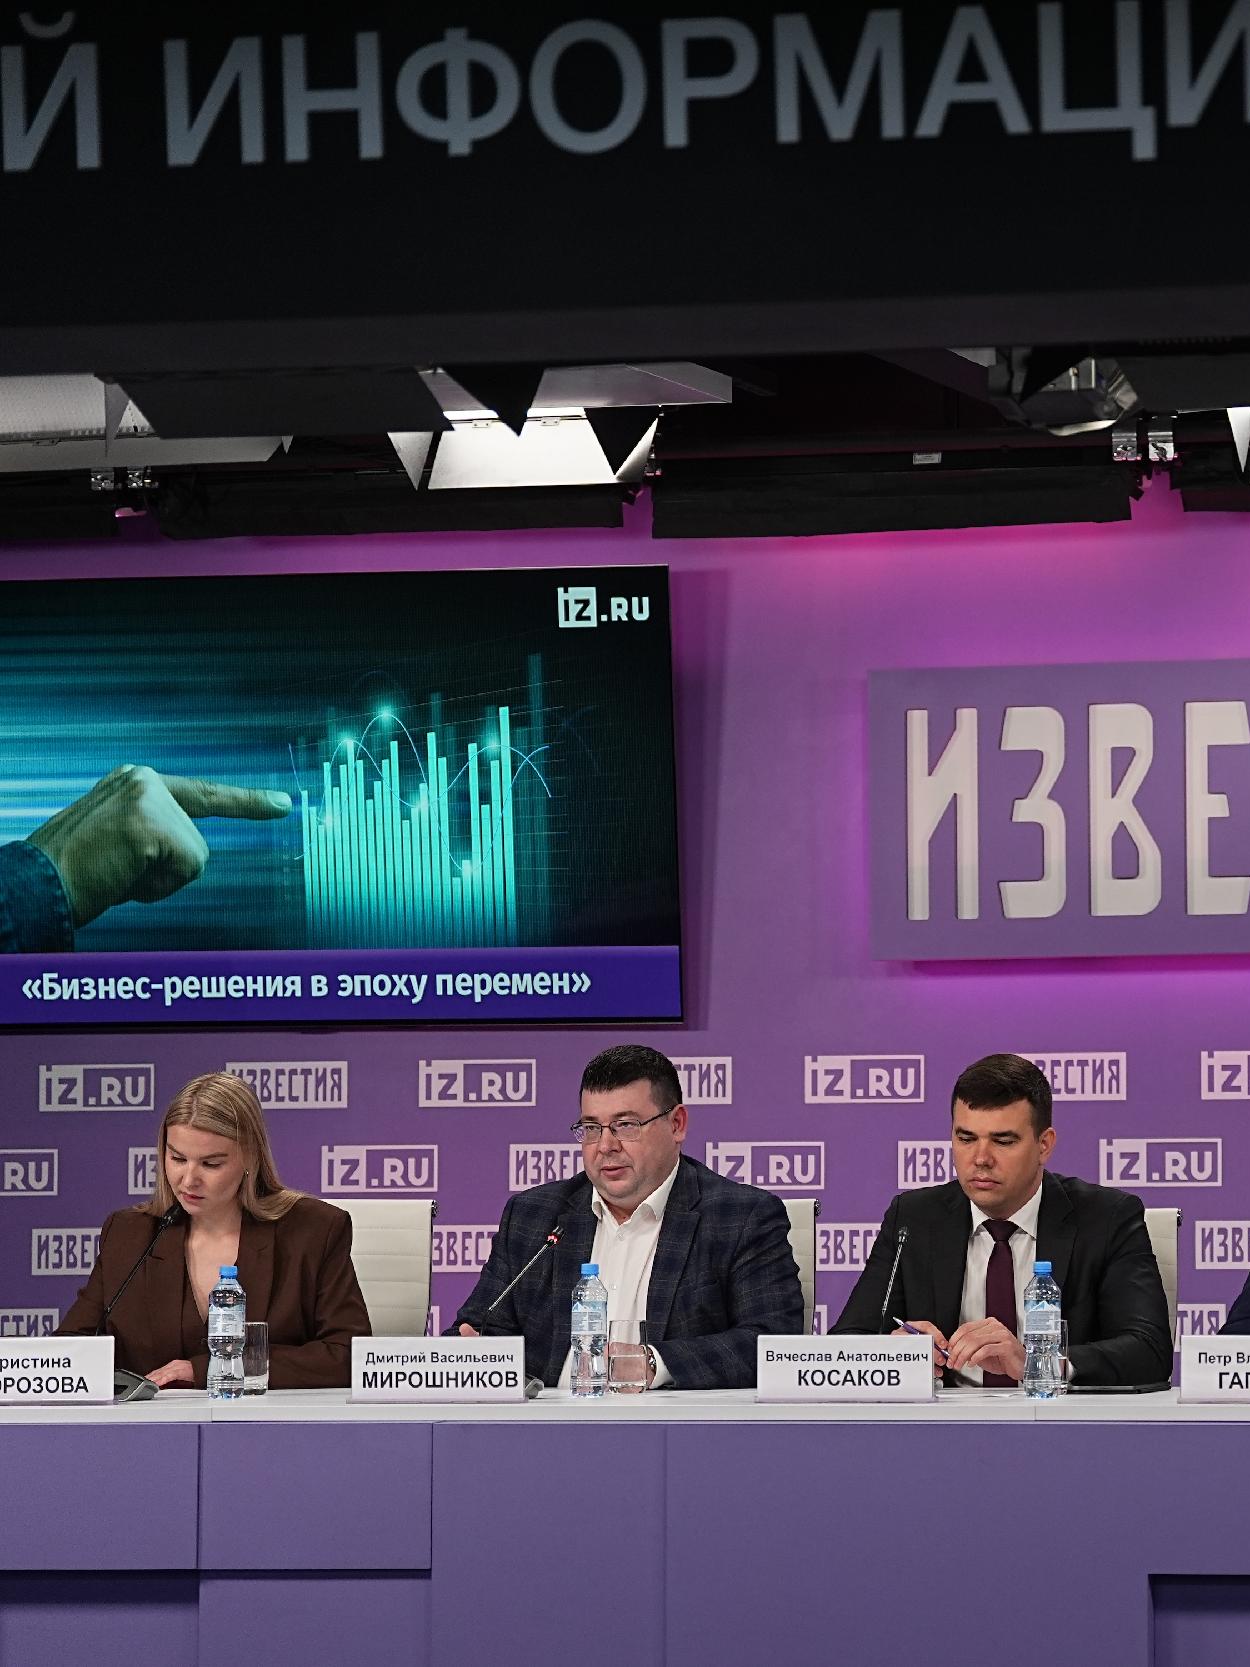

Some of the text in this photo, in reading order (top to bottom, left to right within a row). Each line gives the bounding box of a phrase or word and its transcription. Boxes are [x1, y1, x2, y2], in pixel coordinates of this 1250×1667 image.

[21, 971, 591, 1005] «Бизнес-решения в эпоху перемен»
[365, 1351, 514, 1366] Дмитрий Васильевич
[765, 1350, 929, 1363] Вячеслав Анатольевич
[1198, 1352, 1231, 1367] Петр
[0, 1376, 89, 1394] РОЗОВА
[362, 1370, 519, 1390] МИРОШНИКОВ
[797, 1369, 901, 1388] КОСАКОВ
